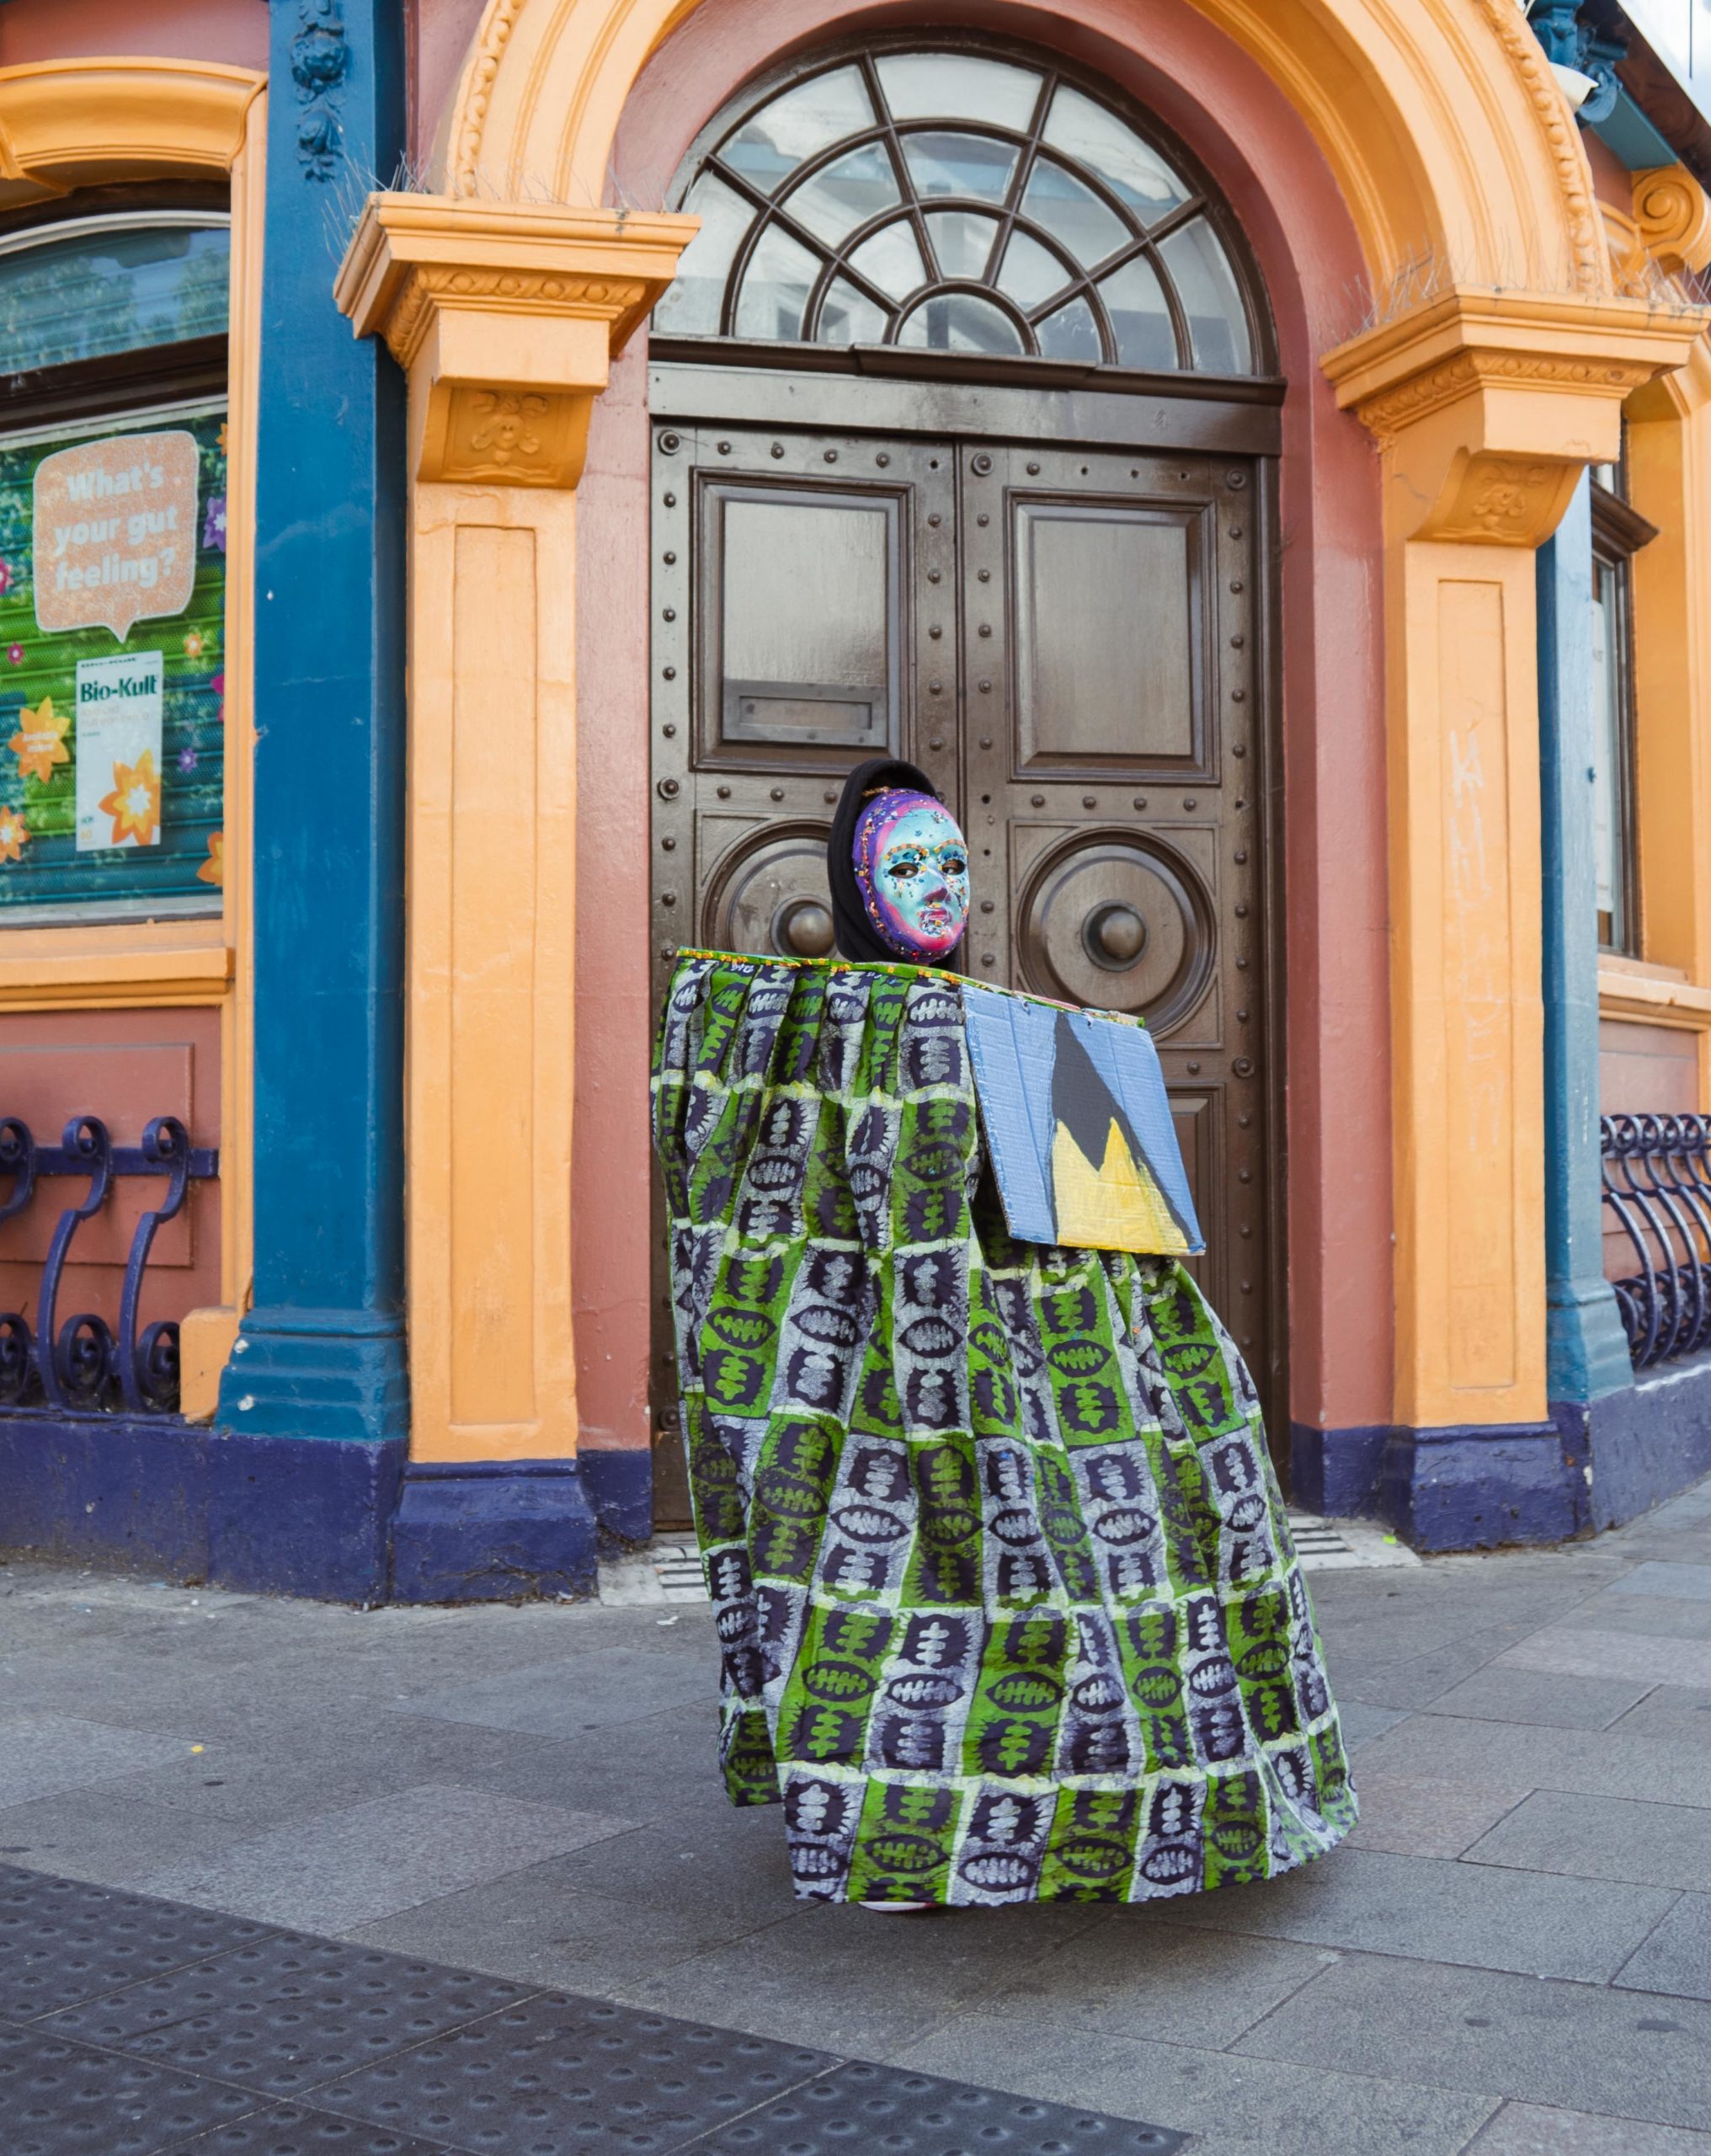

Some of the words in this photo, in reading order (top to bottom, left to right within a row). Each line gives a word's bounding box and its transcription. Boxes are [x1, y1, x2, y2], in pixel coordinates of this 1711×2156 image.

[67, 461, 163, 501] What's
[54, 517, 120, 557] your
[128, 505, 177, 545] gut
[55, 547, 176, 591] feeling?
[81, 675, 157, 702] Bio-Kult
